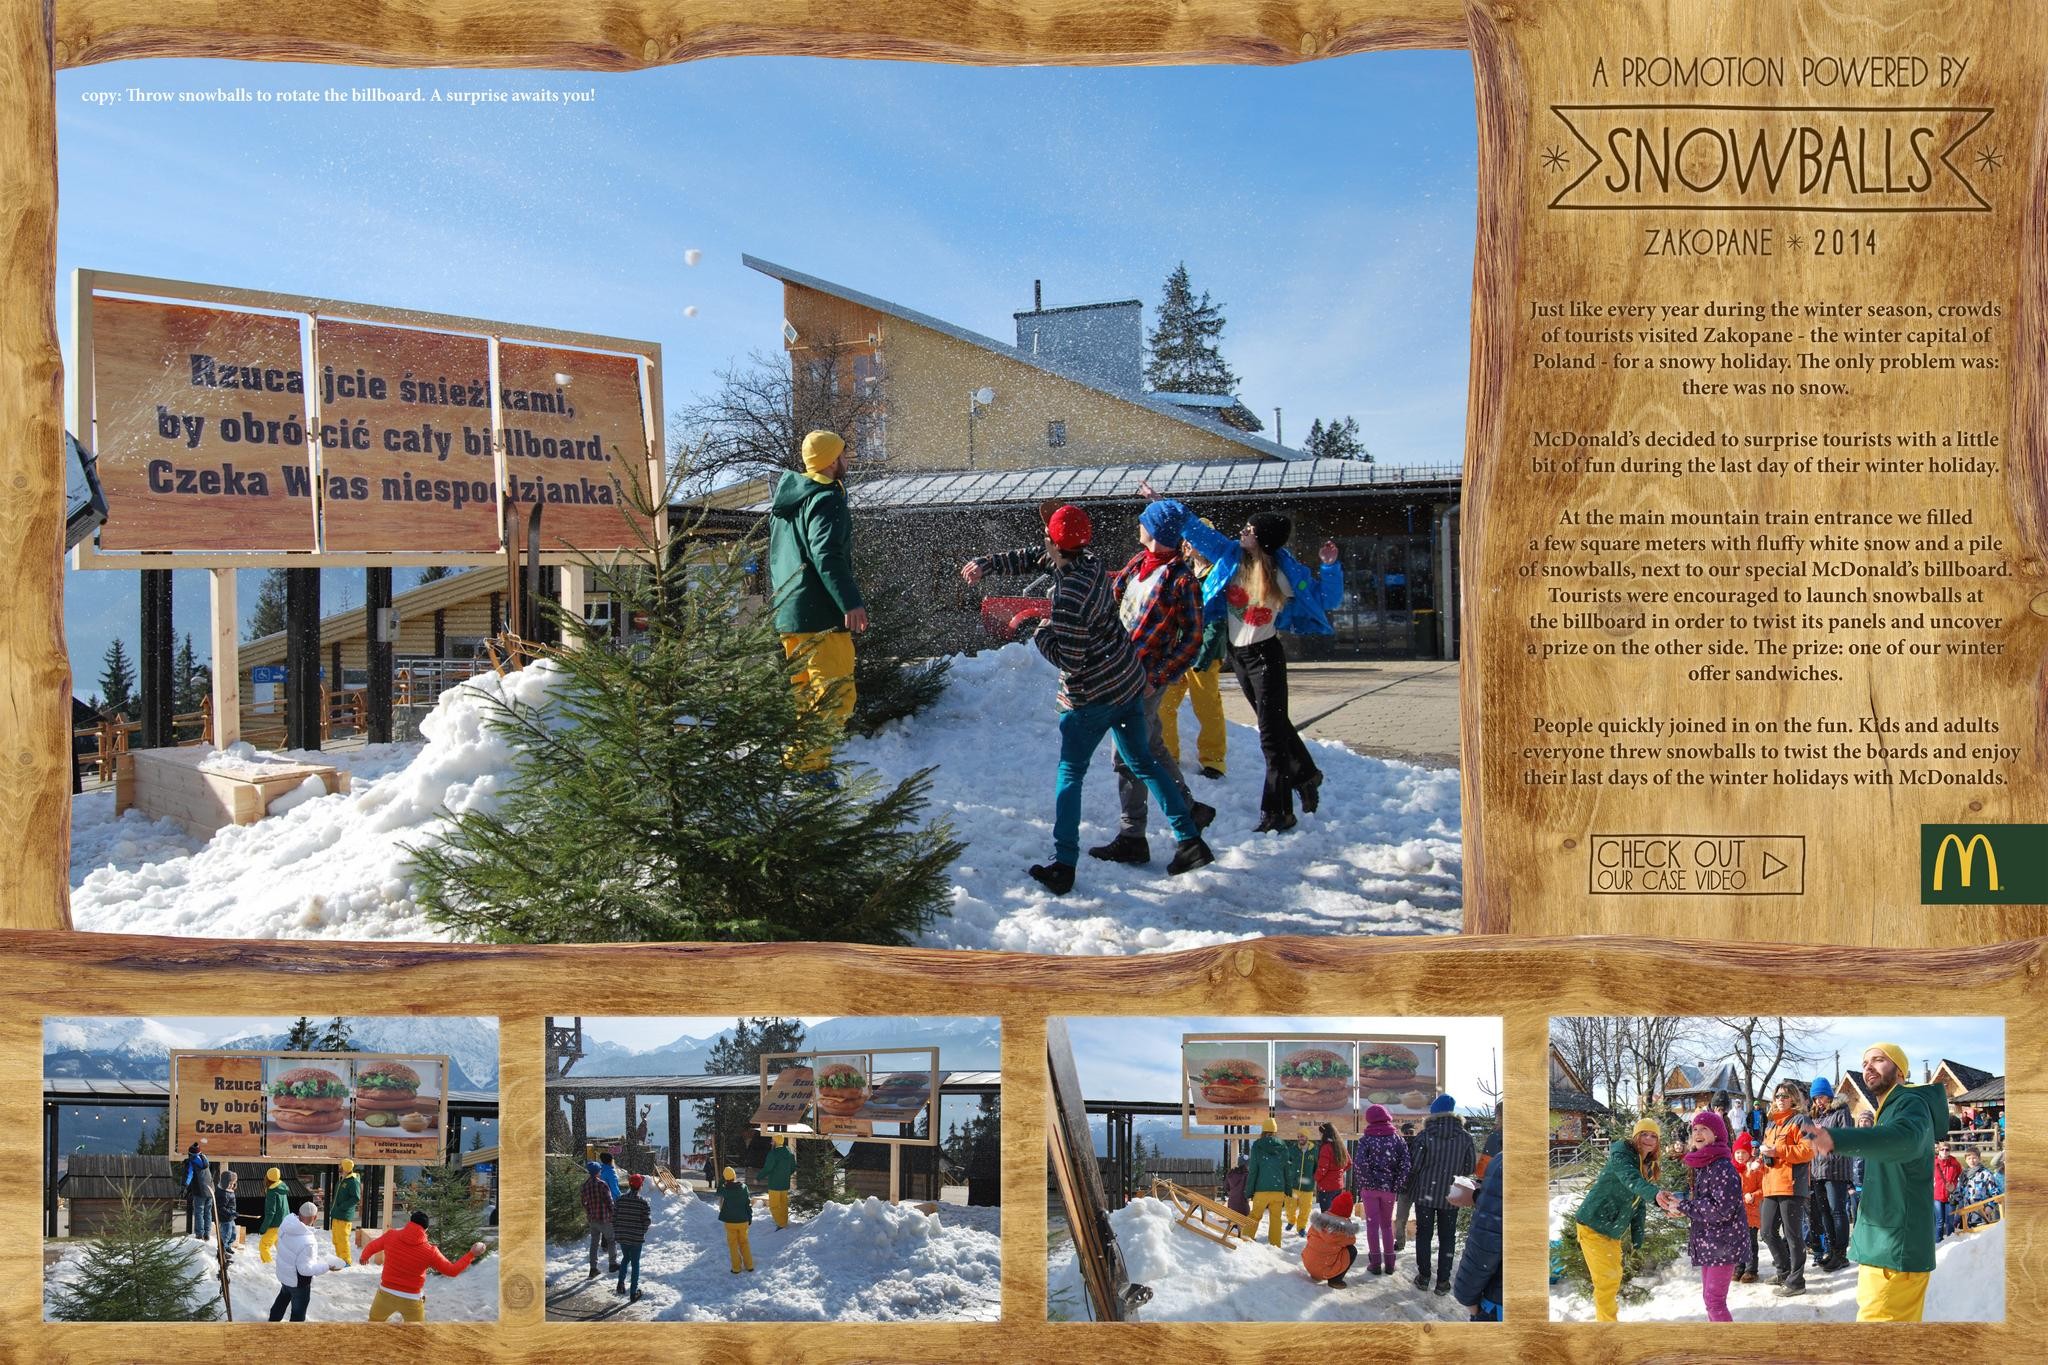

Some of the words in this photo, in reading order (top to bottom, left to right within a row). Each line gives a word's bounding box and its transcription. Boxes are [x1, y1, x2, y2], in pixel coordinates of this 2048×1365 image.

[157, 405, 204, 448] by
[383, 423, 451, 461] cały
[149, 460, 269, 496] Czeka
[200, 1098, 219, 1116] by
[195, 1119, 243, 1134] Czeka
